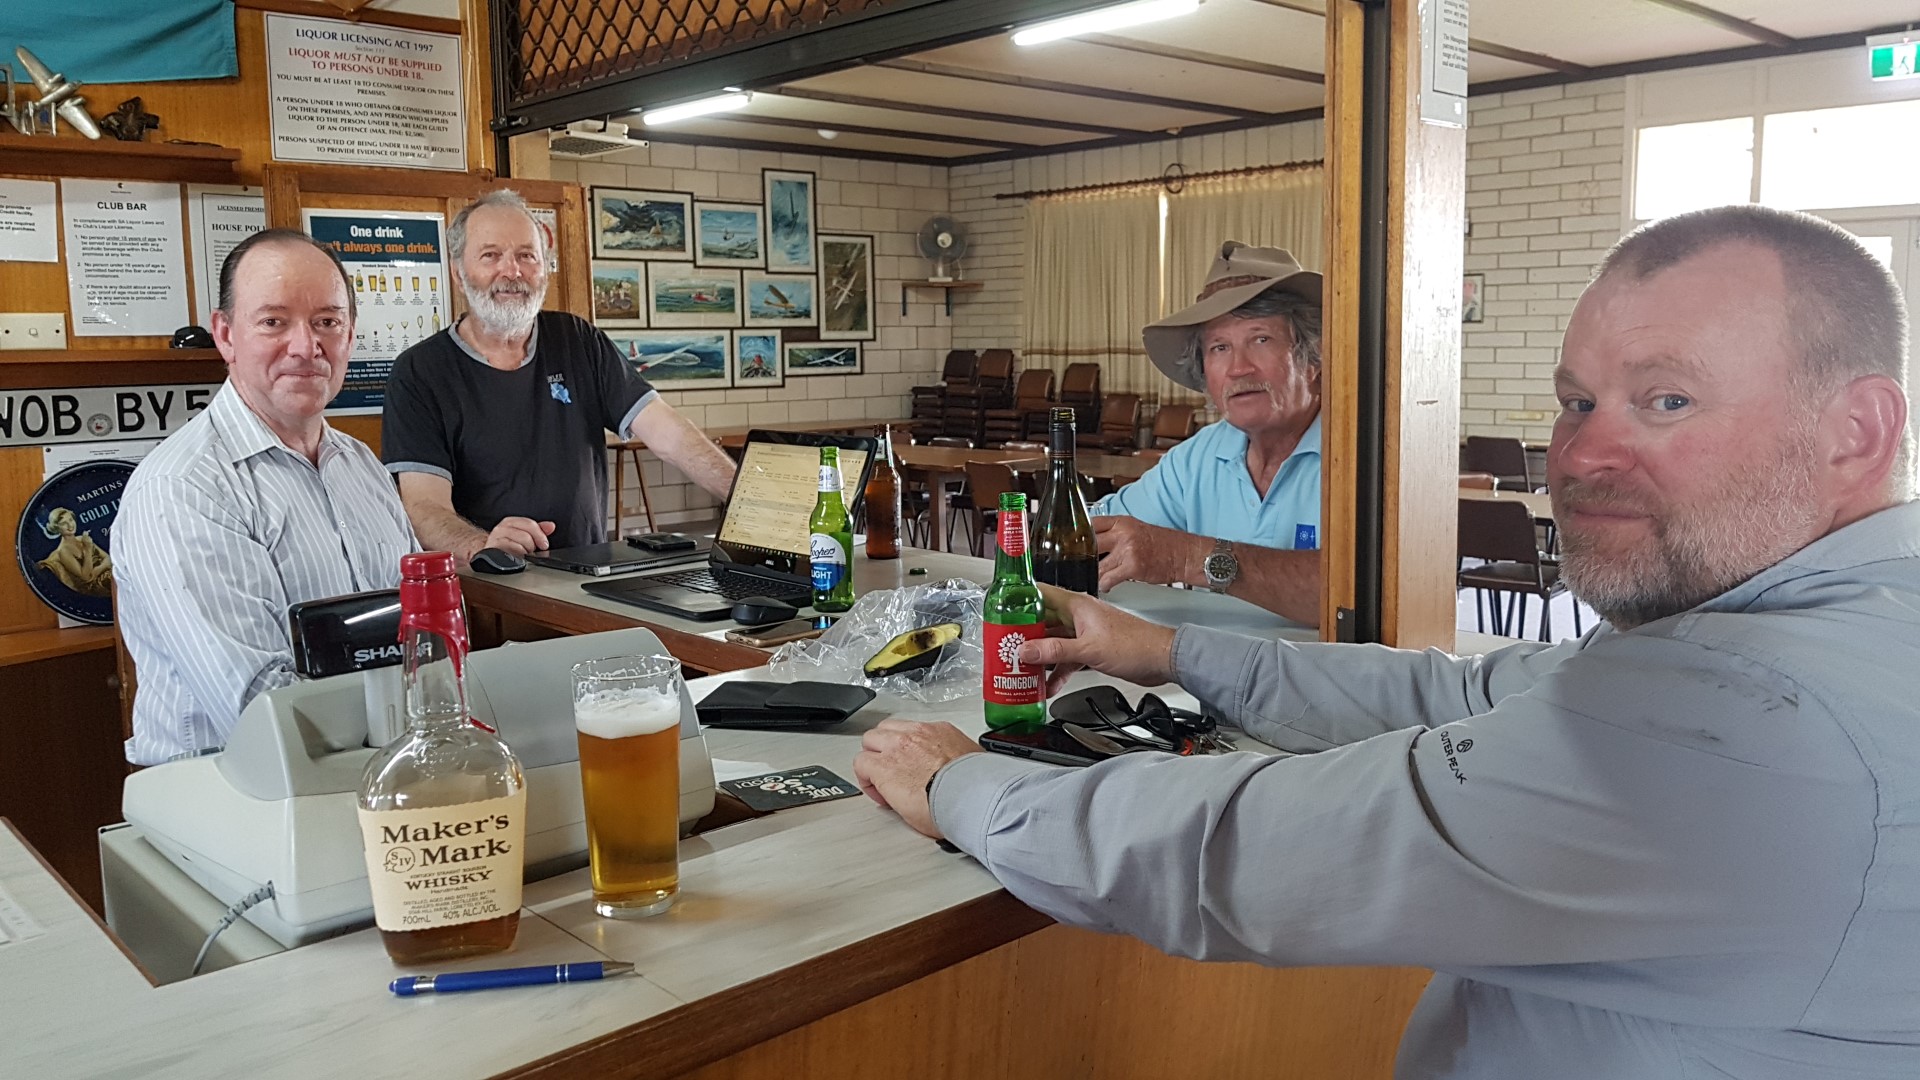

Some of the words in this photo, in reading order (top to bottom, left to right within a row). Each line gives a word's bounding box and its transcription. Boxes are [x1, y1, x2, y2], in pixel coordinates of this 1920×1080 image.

[296, 28, 338, 40] LIQUOR
[341, 32, 392, 48] LICENSING
[394, 40, 410, 50] ACT
[414, 43, 434, 52] 1997
[288, 47, 330, 58] LIQUOR
[334, 52, 362, 62] MUST
[365, 54, 386, 64] NOT
[388, 57, 400, 66] BE
[401, 59, 442, 72] SUPPLIED
[312, 60, 326, 70] TO
[330, 62, 374, 74] PERSONS
[376, 66, 408, 78] UNDER
[412, 71, 424, 80] 18.
[373, 81, 402, 90] CONSUME
[320, 108, 353, 116] PREMISES,
[402, 106, 434, 115] CONSUMES
[288, 114, 315, 122] LIQUOR
[309, 137, 345, 146] SUSPECTED
[357, 148, 388, 156] EVIDENCE
[97, 201, 124, 210] CLUB
[126, 202, 147, 211] BAR
[212, 223, 243, 231] HOUSE
[350, 225, 372, 238] One
[374, 226, 404, 238] drink
[343, 241, 382, 254] always
[385, 243, 405, 253] one
[407, 242, 437, 254] drink.
[115, 390, 174, 433] BY
[76, 480, 123, 503] MARTINS
[79, 503, 110, 524] GOLD
[994, 675, 1039, 690] STRONGBOW
[1441, 731, 1454, 757] OUTER
[1447, 756, 1468, 785] PEAK
[380, 814, 509, 844] Maker's
[391, 852, 398, 861] S
[420, 838, 510, 867] Mark
[400, 856, 411, 866] IV
[404, 870, 493, 890] WHISKY
[431, 886, 468, 894] Handmade
[402, 914, 431, 924] 700mL
[442, 910, 460, 920] 40%
